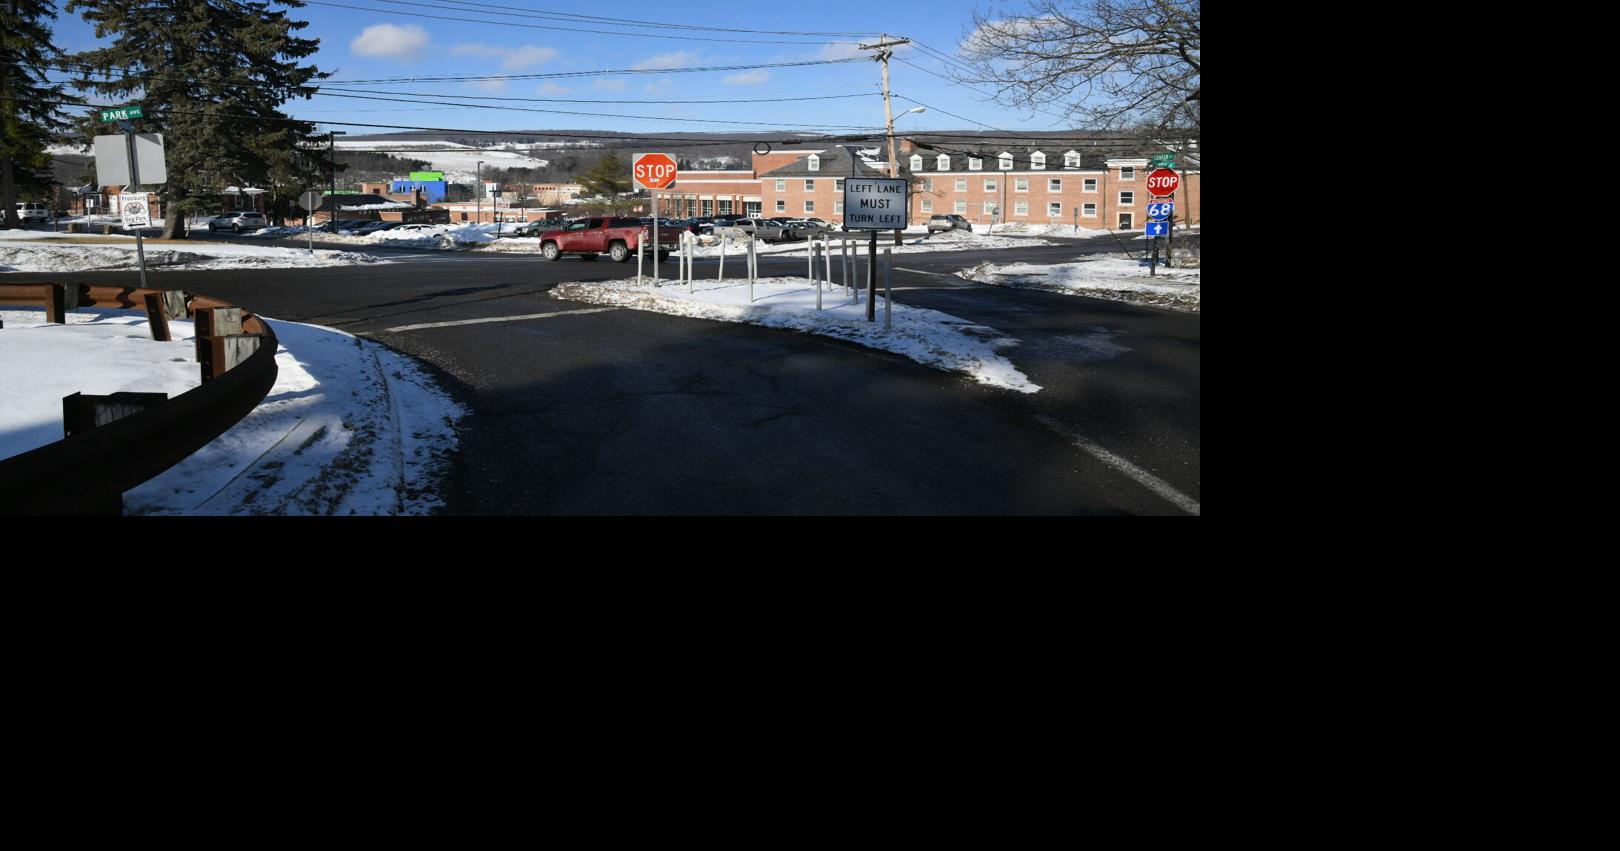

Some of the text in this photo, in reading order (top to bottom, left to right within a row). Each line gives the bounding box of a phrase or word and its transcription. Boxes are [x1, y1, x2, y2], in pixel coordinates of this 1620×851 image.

[102, 110, 129, 120] PARK
[636, 164, 675, 178] STOP
[1148, 176, 1178, 188] STOP
[850, 184, 902, 194] LEFT LANE
[860, 198, 891, 209] MUST
[1149, 203, 1171, 216] 68
[849, 214, 901, 223] TURN LEFT
